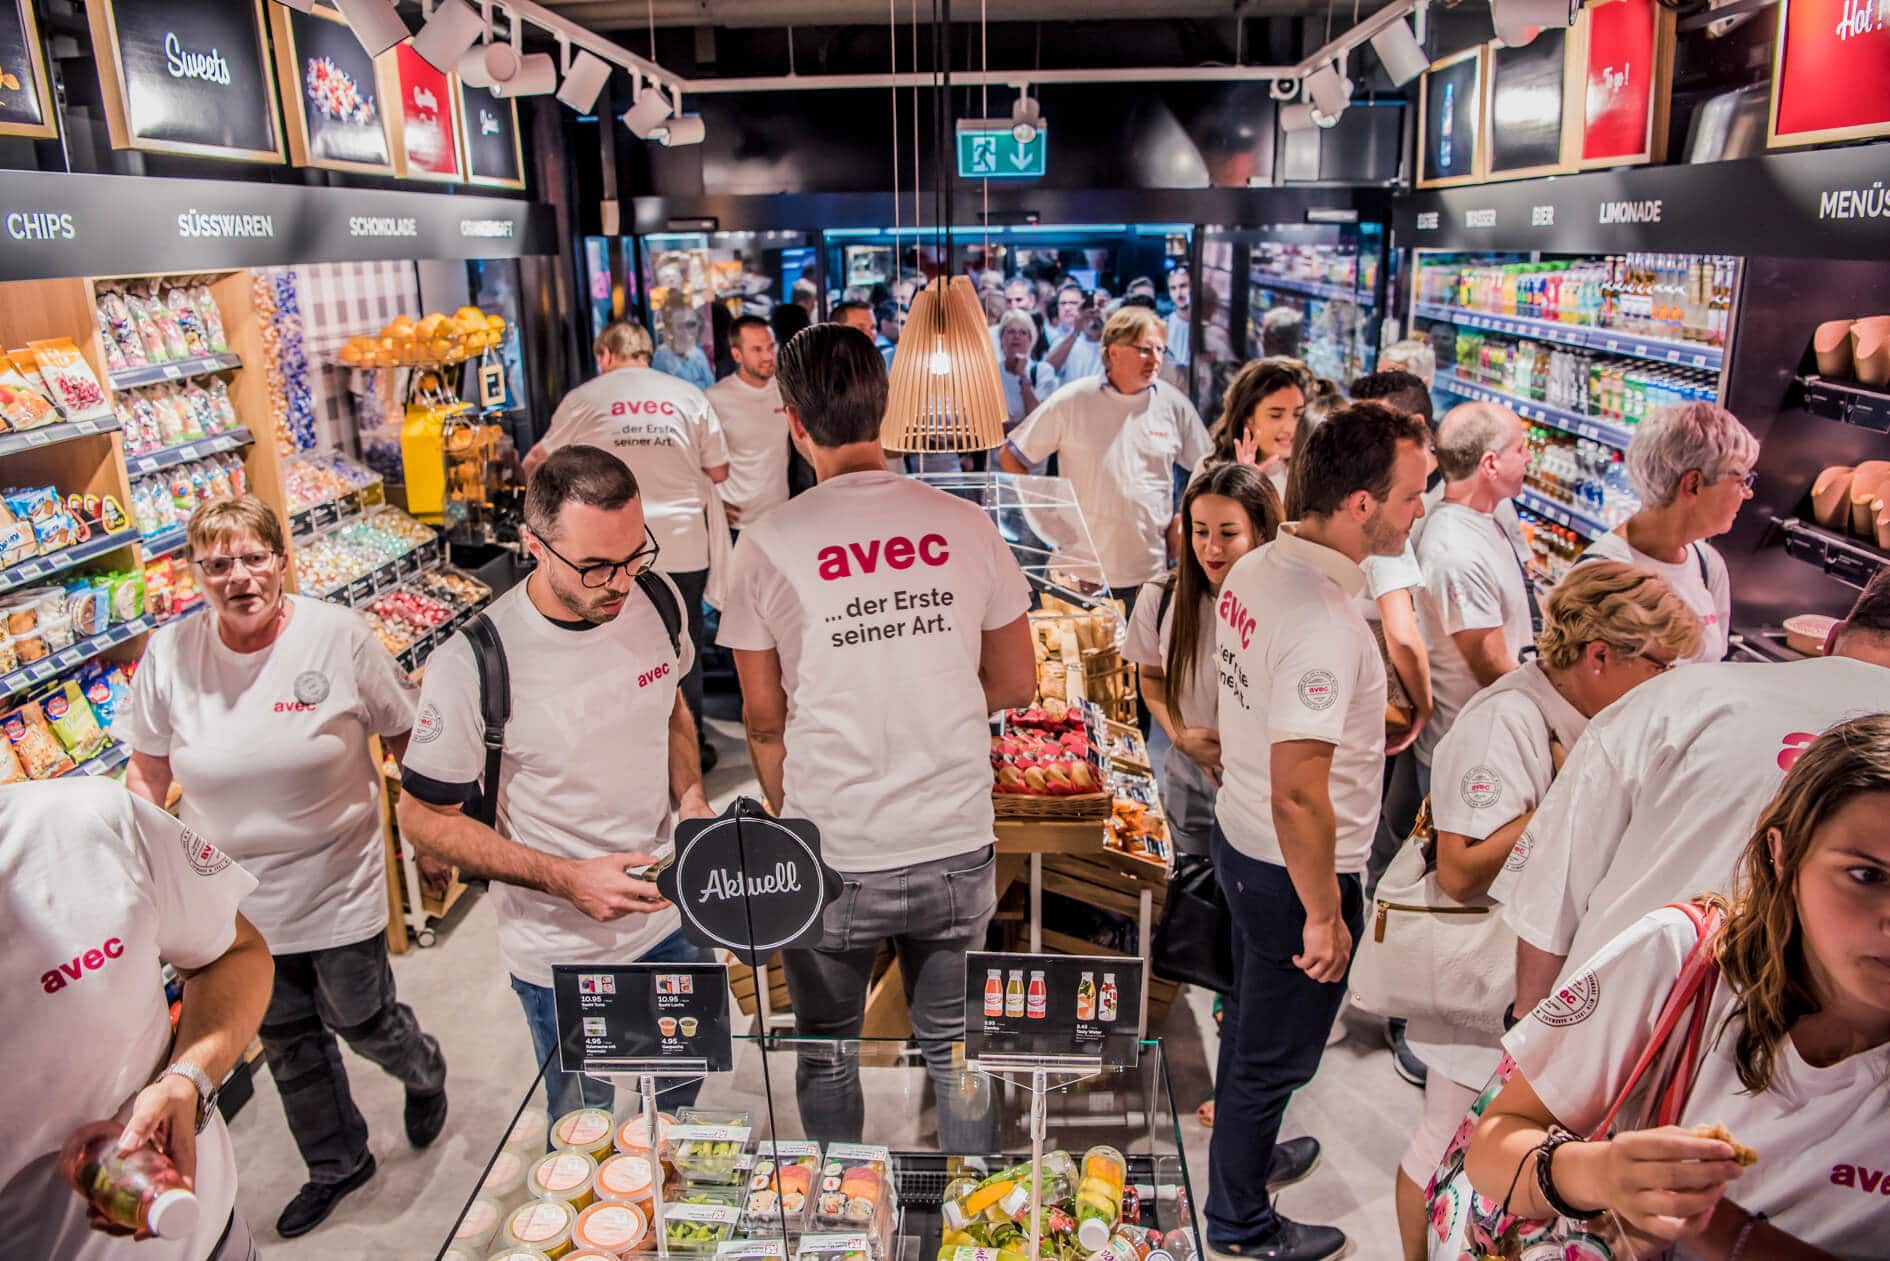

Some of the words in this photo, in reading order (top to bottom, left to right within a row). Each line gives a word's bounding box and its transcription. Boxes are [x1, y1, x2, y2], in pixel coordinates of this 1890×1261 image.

[163, 31, 231, 86] Sweets
[178, 208, 273, 239] SÜSSWAREN
[1599, 200, 1662, 223] LIMONADE
[7, 213, 75, 240] CHIPS
[349, 216, 417, 237] SCHOKOLADE
[611, 399, 674, 417] avec
[817, 533, 950, 581] avec
[894, 588, 954, 610] Erste
[831, 622, 906, 648] seiner
[911, 613, 952, 636] Art.
[637, 662, 670, 688] avec
[274, 702, 318, 713] avec
[698, 860, 801, 904] Aktuell
[41, 937, 124, 994] avec
[581, 995, 602, 1003] 10.95
[657, 995, 679, 1003] 10.95
